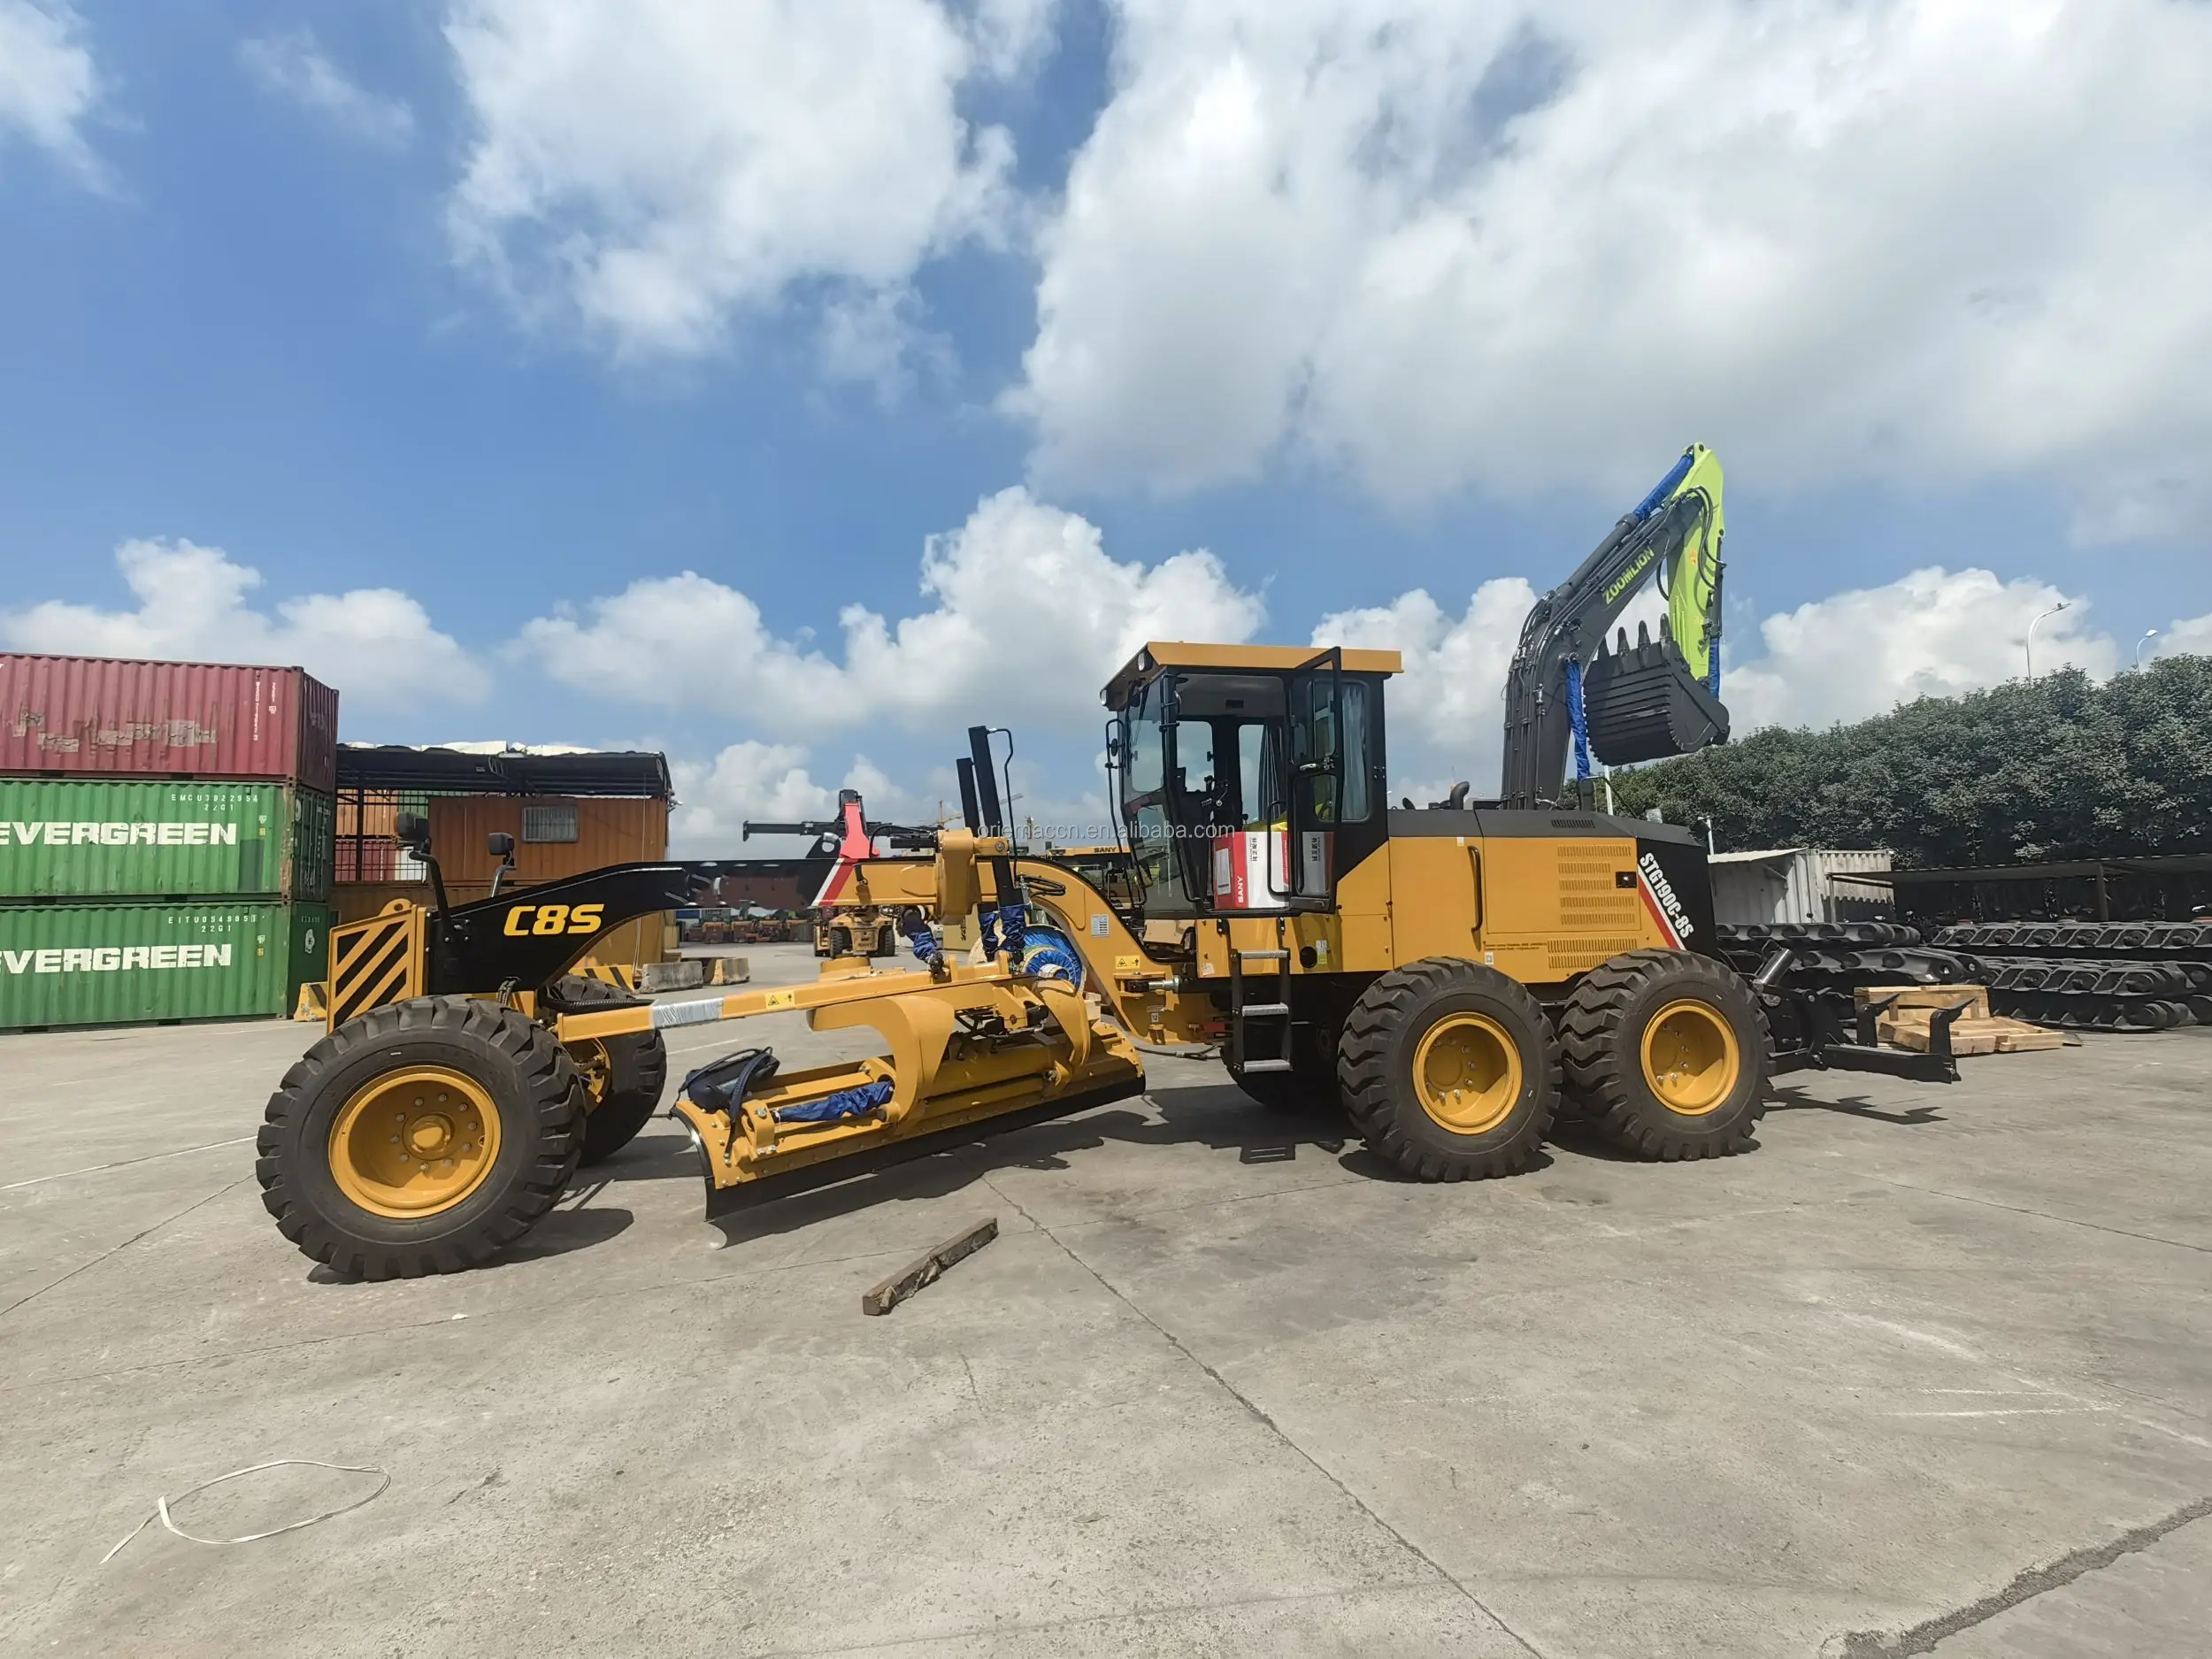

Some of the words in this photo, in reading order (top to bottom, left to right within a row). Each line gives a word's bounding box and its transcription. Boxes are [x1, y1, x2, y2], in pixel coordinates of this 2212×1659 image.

[1602, 546, 1655, 604] ZOOMLION
[1640, 852, 1694, 938] STG190C-8S
[503, 903, 605, 936] C8S
[0, 944, 232, 973] VERGREEN
